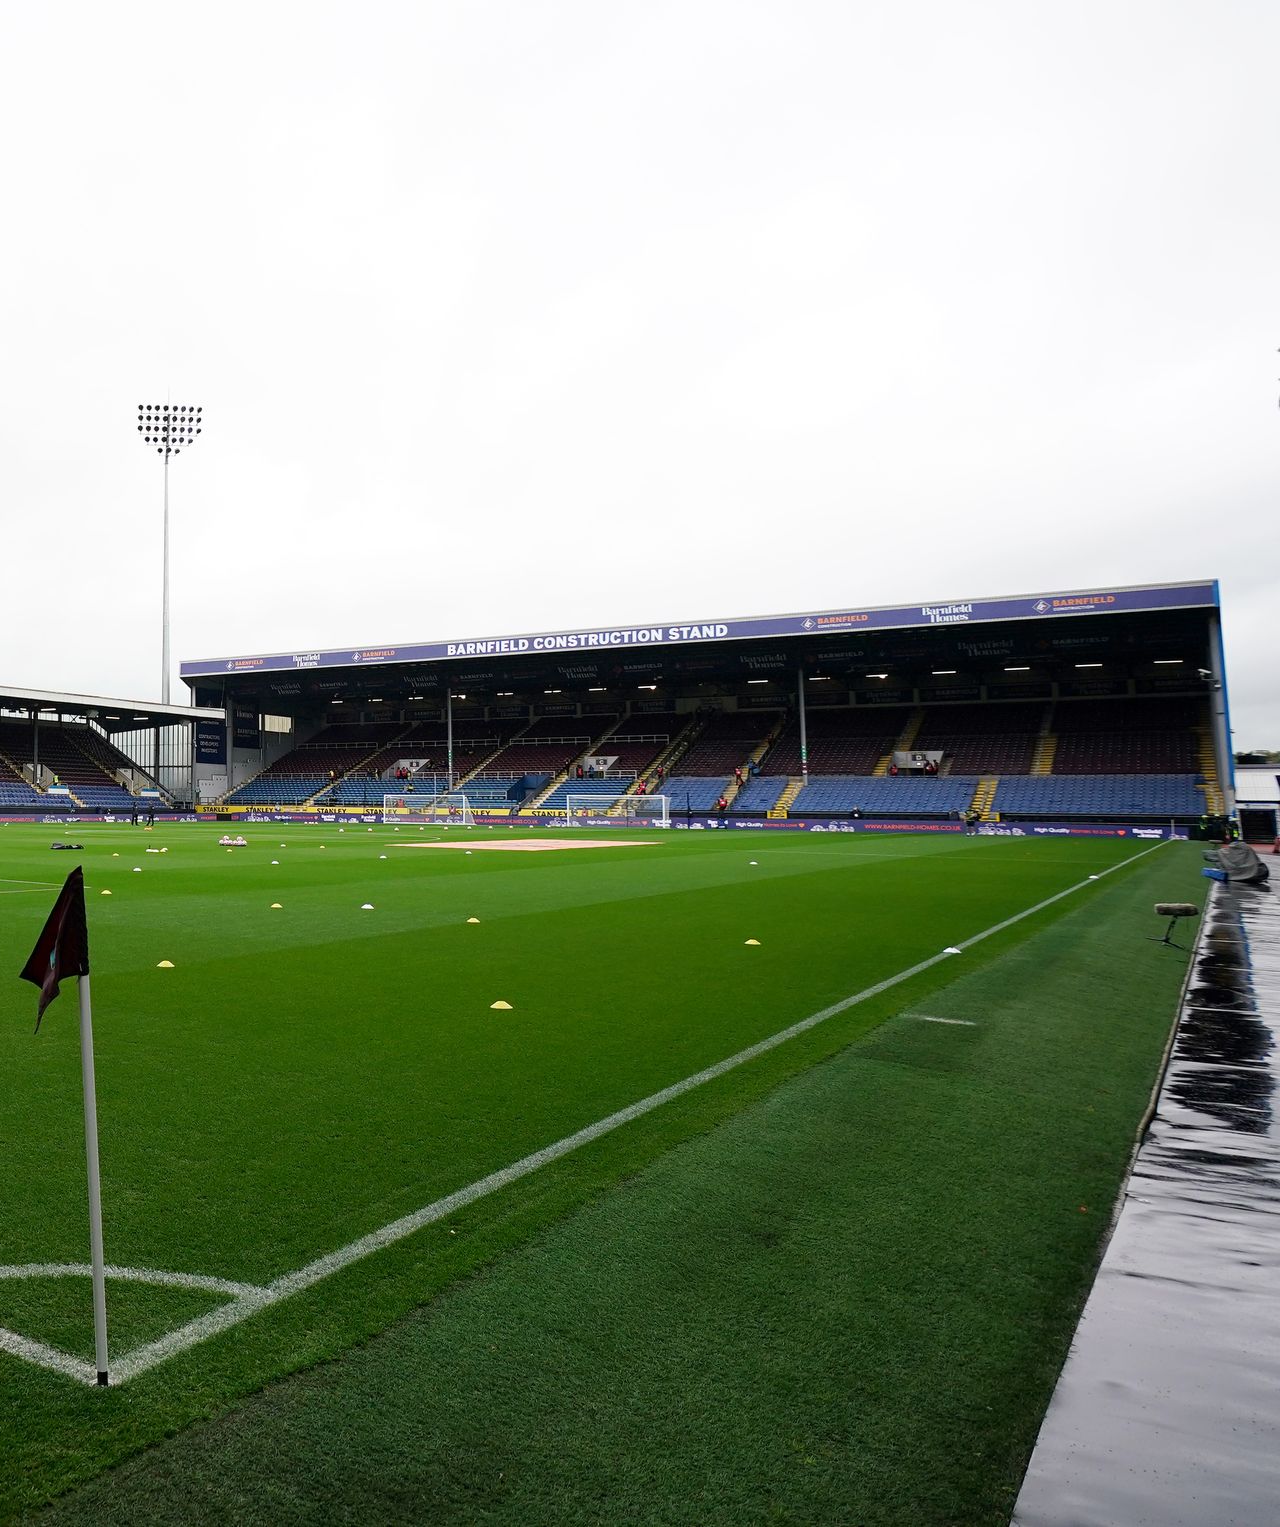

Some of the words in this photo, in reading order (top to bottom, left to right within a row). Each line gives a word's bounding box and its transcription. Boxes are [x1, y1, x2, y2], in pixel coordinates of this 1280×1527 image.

[1053, 596, 1115, 607] BARNFIELD
[921, 604, 972, 616] Barnfield
[817, 614, 868, 625] BARNFIELD
[930, 613, 969, 623] Homes
[447, 638, 529, 656] BARNFIELD
[533, 628, 663, 650] CONSTRUCTION
[669, 624, 728, 641] STAND
[292, 653, 320, 662] Barnfield
[362, 650, 395, 658] BARNFIELD
[296, 660, 318, 668] Homes
